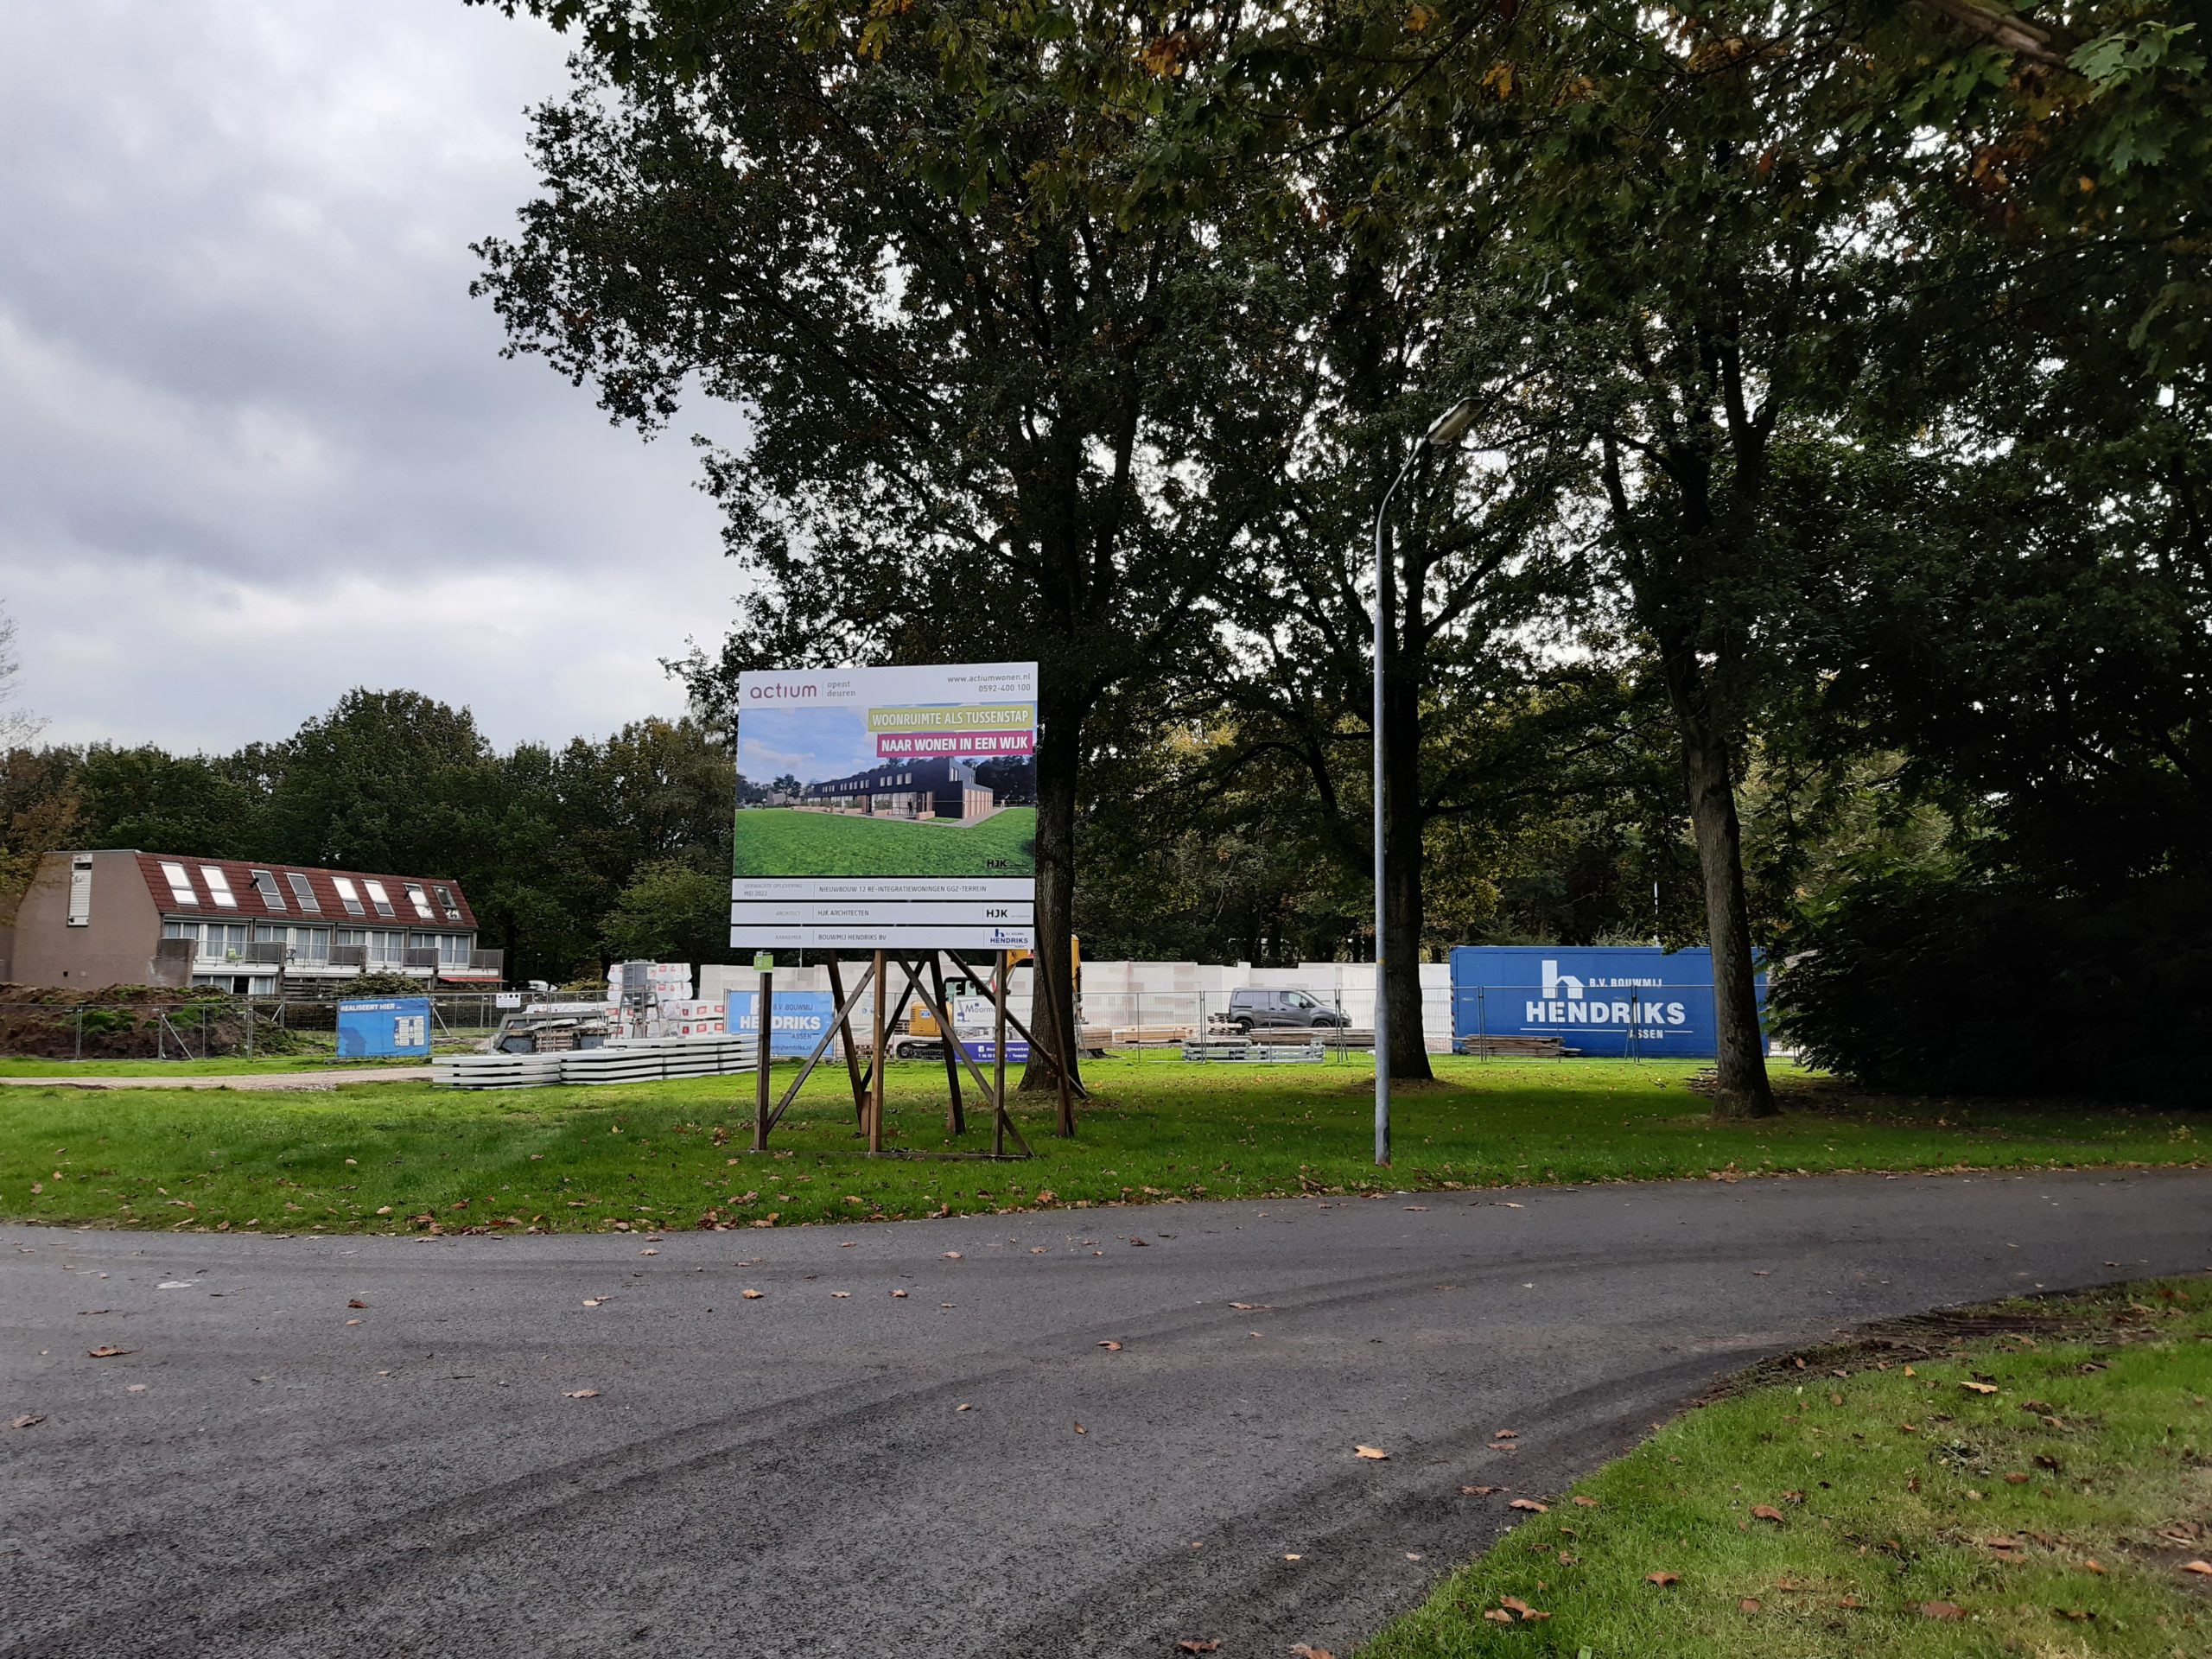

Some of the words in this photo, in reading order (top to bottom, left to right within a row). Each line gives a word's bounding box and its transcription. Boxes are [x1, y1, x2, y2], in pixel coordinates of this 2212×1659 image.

[827, 680, 850, 689] opent
[947, 673, 1031, 683] www.actiumwonen.nl
[750, 683, 817, 699] actium
[827, 689, 855, 697] deuren
[872, 711, 941, 726] WOONRUIMTE
[944, 711, 963, 724] ALS
[966, 709, 1029, 723] TUSSENSTAP
[881, 739, 912, 752] NAAR
[914, 737, 957, 751] WONEN
[960, 737, 972, 750] IN
[975, 736, 997, 750] EEN
[1000, 735, 1028, 749] WIJK
[986, 909, 1008, 918] HJK
[1611, 978, 1662, 988] BOUWMIJ
[1526, 1001, 1686, 1026] HENDRIKS
[740, 1015, 821, 1031] HEDRIKS
